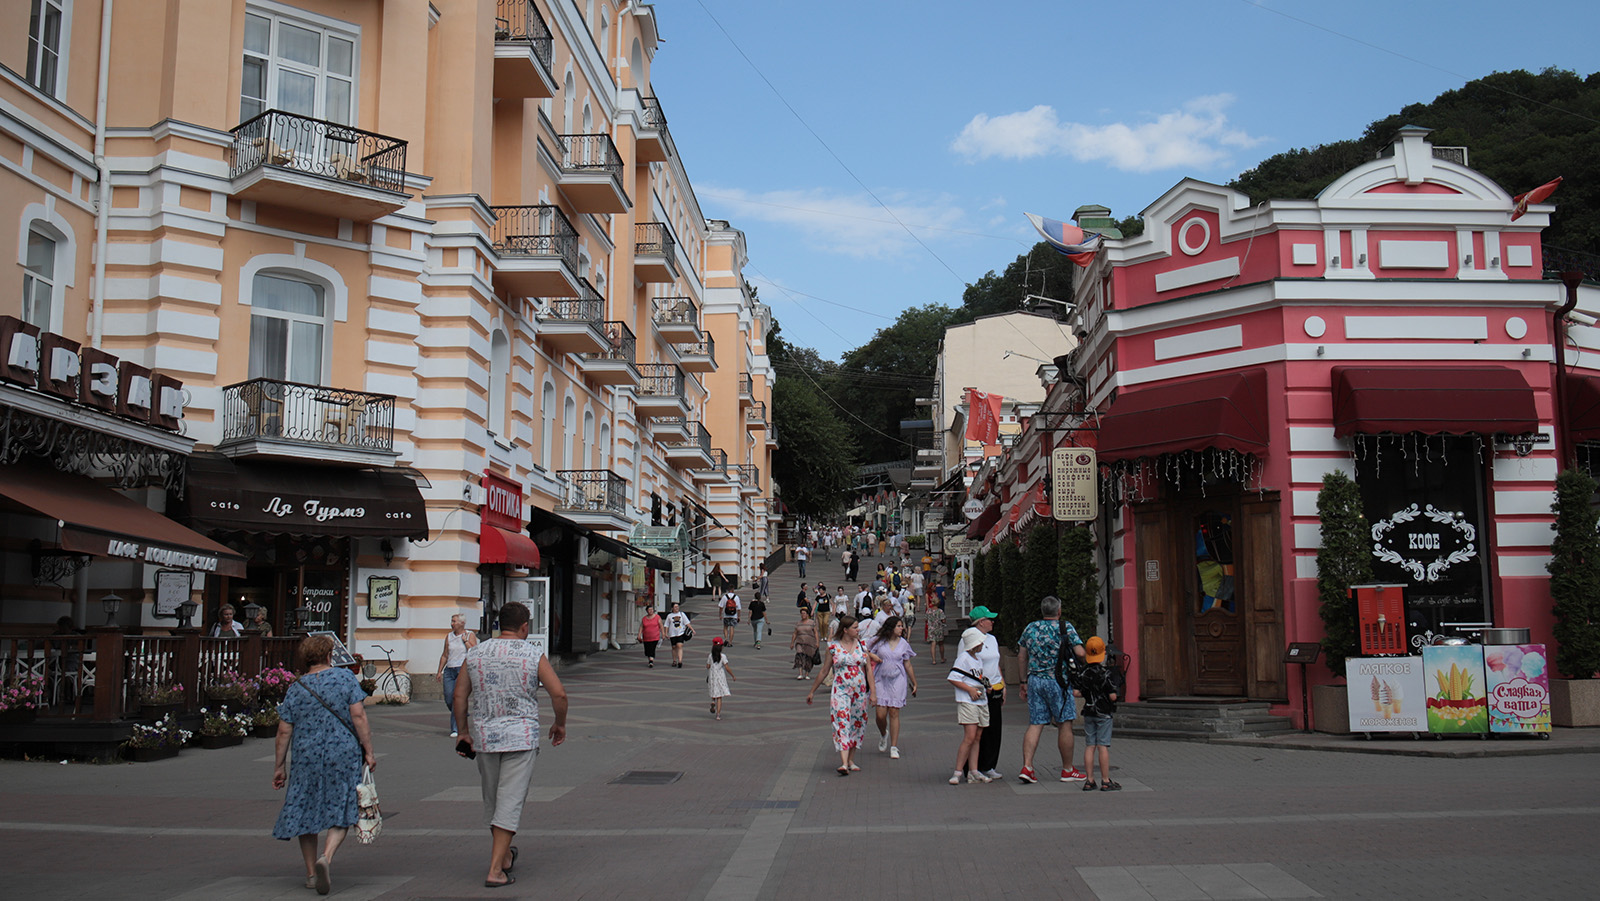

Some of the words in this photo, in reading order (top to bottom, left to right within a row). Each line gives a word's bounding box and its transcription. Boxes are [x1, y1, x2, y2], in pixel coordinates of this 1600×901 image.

[489, 484, 521, 519] ОПТИКА
[210, 500, 240, 510] cafe
[262, 496, 294, 517] Ля
[303, 500, 366, 522] Гурмэ
[1408, 533, 1440, 550] КОФЕ
[107, 539, 139, 559] КАФЕ
[145, 546, 218, 572] КОНДИТЕРСКАЯ
[292, 585, 334, 598] Звтраки
[1359, 663, 1411, 675] МЯГКОЕ
[1496, 686, 1542, 700] Сладкая
[1504, 701, 1537, 712] вата
[1360, 718, 1417, 727] МОРОЖЕНОЕ
